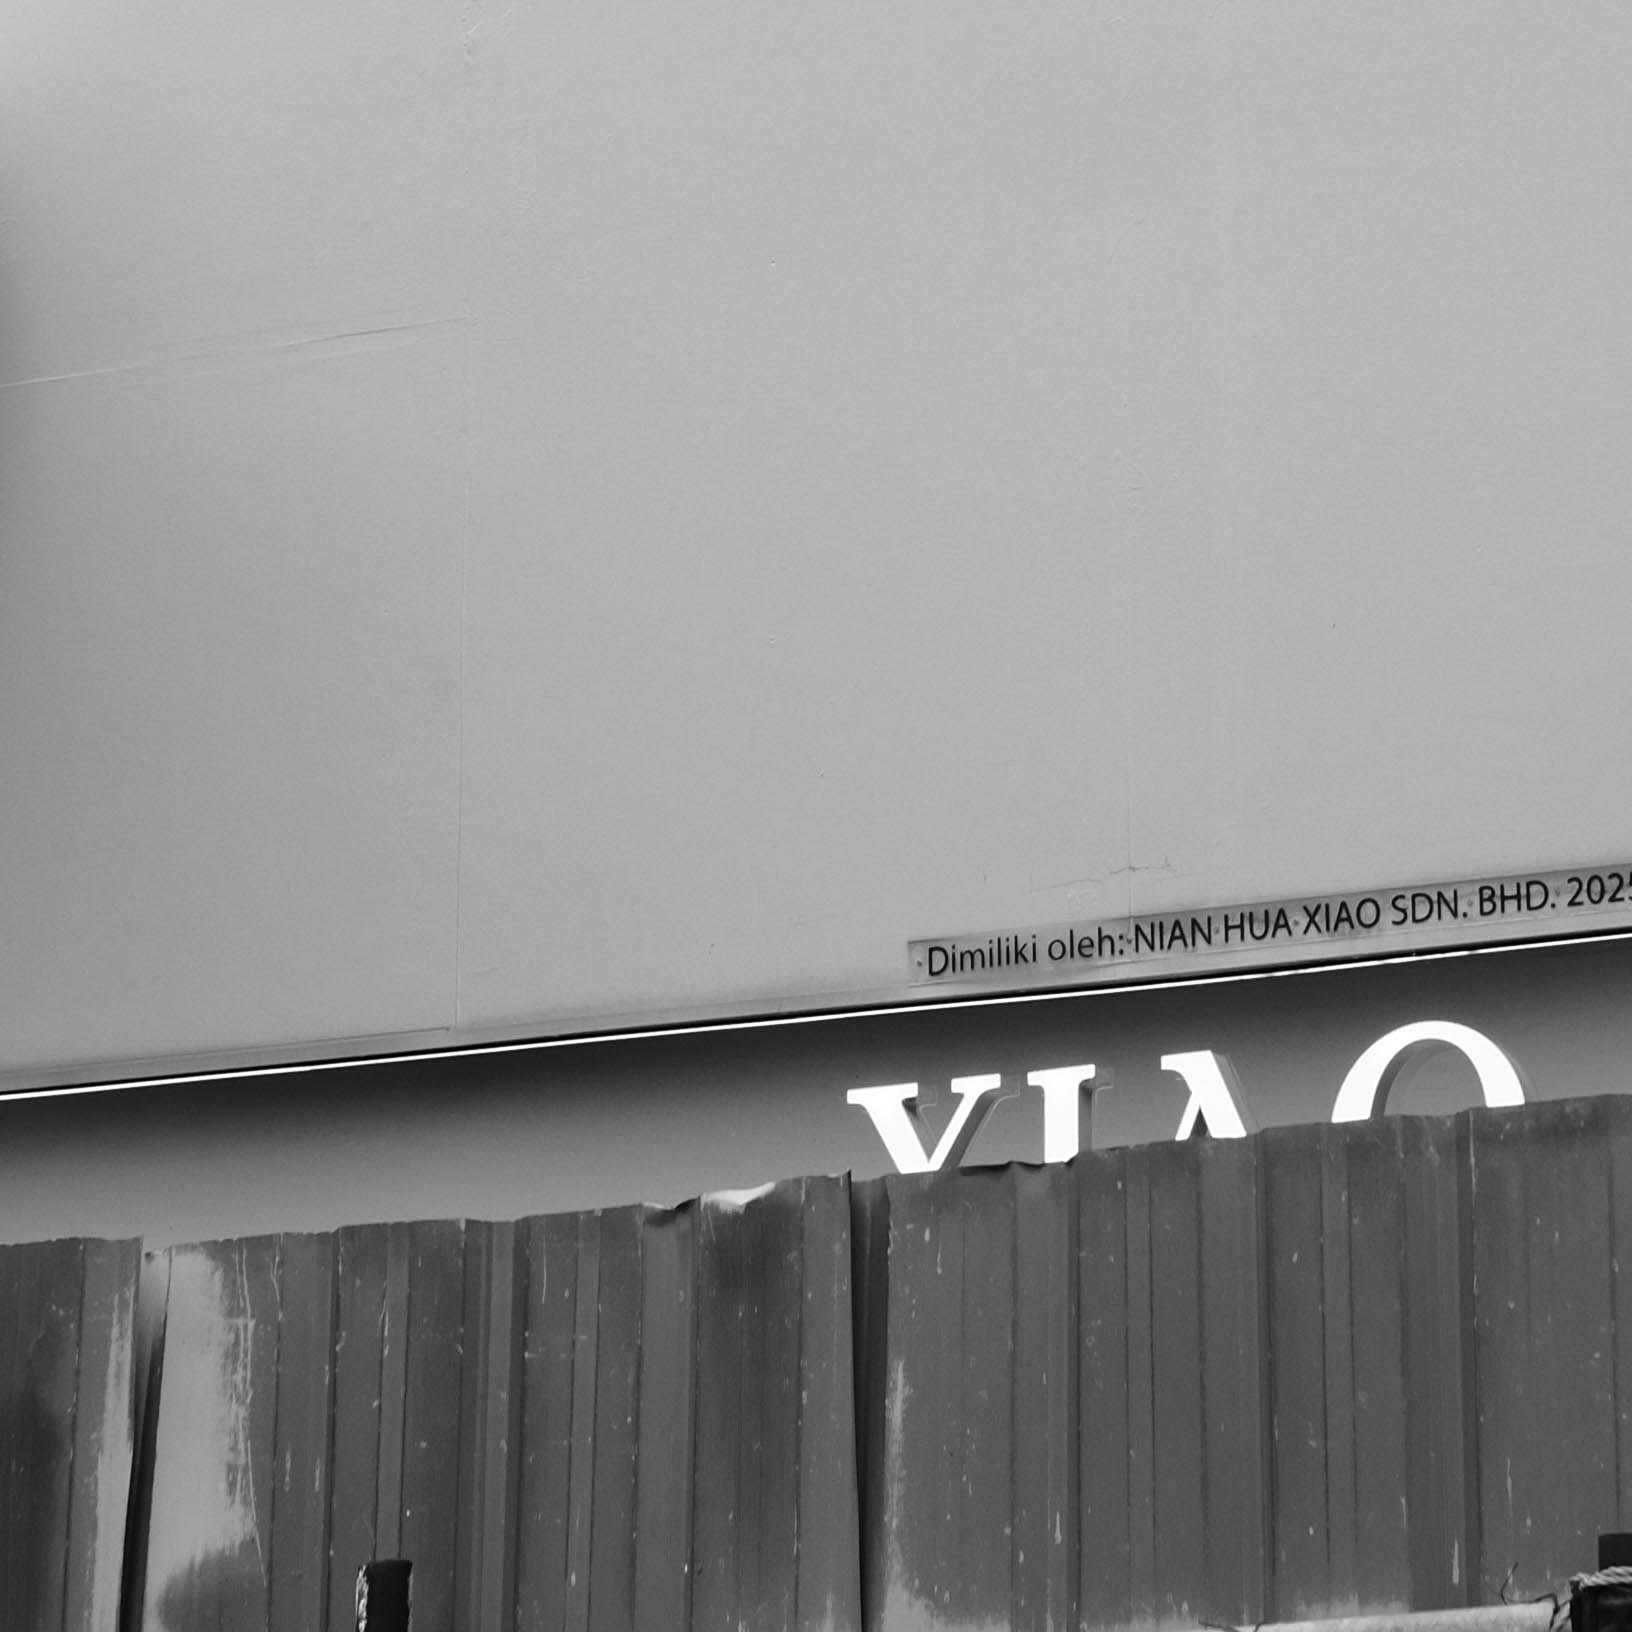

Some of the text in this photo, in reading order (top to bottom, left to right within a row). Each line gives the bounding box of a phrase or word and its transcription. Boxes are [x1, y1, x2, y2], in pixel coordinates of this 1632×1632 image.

[927, 933, 1039, 976] Dimiliki
[1047, 925, 1126, 962] oleh:
[1132, 915, 1213, 954] NIAN
[1222, 907, 1293, 945] HUA
[1301, 897, 1381, 936] XIAO
[1390, 887, 1469, 926] SDN.
[1477, 879, 1556, 917] BHD.
